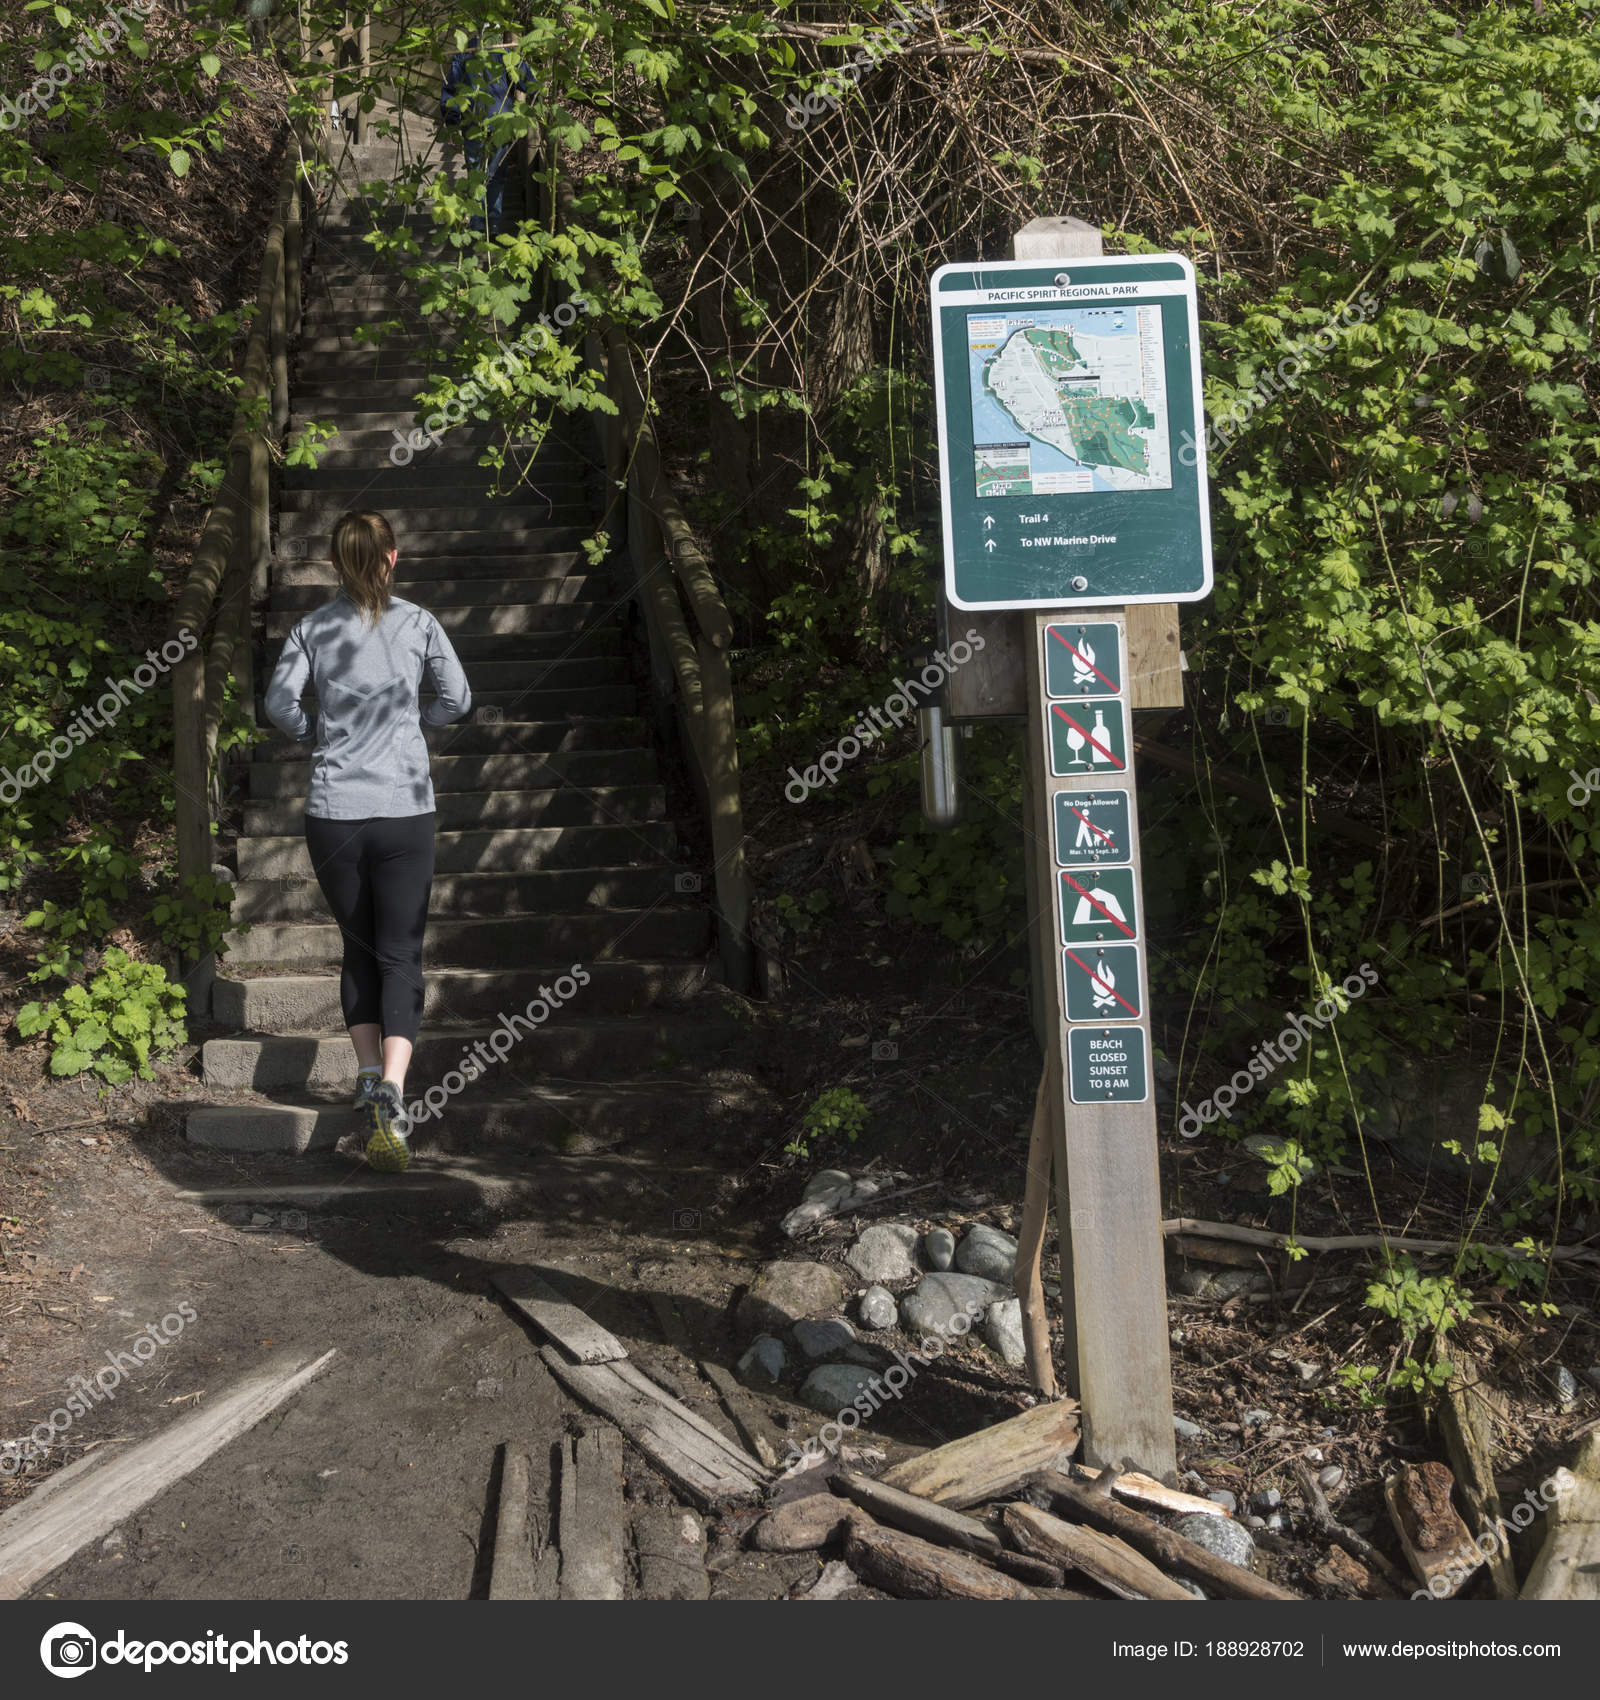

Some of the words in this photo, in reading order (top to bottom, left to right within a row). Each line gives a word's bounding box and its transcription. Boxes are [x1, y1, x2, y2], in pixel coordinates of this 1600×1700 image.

[988, 290, 1025, 301] PACIFIC
[1028, 289, 1058, 300] SPIRIT
[1060, 287, 1110, 298] REGIONAL
[1113, 285, 1138, 295] PARK
[1019, 514, 1041, 524] Trail
[1042, 514, 1049, 523] 4
[1020, 538, 1032, 547] To
[1034, 537, 1051, 547] NW
[1053, 536, 1089, 546] Marine
[1090, 535, 1117, 544] Drive
[1089, 1039, 1123, 1049] BEACH
[1088, 1052, 1128, 1062] CLOSED
[1089, 1065, 1128, 1075] SUNSET
[1088, 1079, 1103, 1088] TO
[1104, 1079, 1111, 1088] 8
[1112, 1078, 1129, 1088] AM
